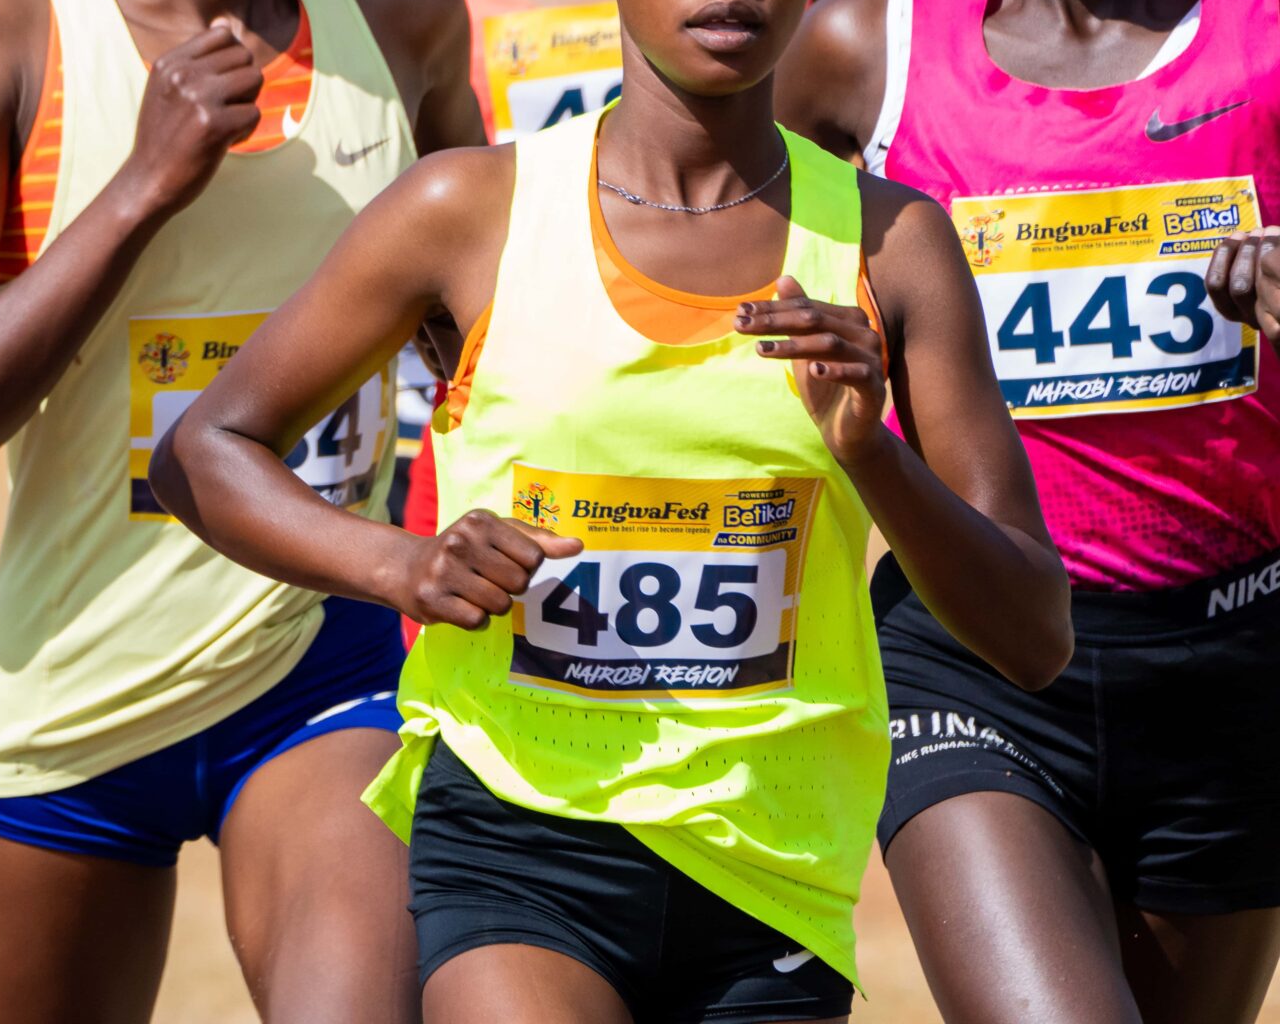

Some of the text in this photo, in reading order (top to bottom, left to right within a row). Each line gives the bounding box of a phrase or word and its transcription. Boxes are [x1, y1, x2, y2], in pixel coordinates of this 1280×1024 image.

[1016, 213, 1150, 242] BingwaFest
[1165, 206, 1239, 235] Betika!
[997, 272, 1214, 365] 443
[1025, 368, 1202, 406] NAIROBI REGION
[572, 499, 710, 523] BingwaFest
[725, 500, 794, 526] Betika!
[686, 526, 710, 534] legends
[728, 530, 793, 544] COMMUNITY
[542, 562, 758, 648] 485
[564, 662, 739, 687] NAIROBI REGION
